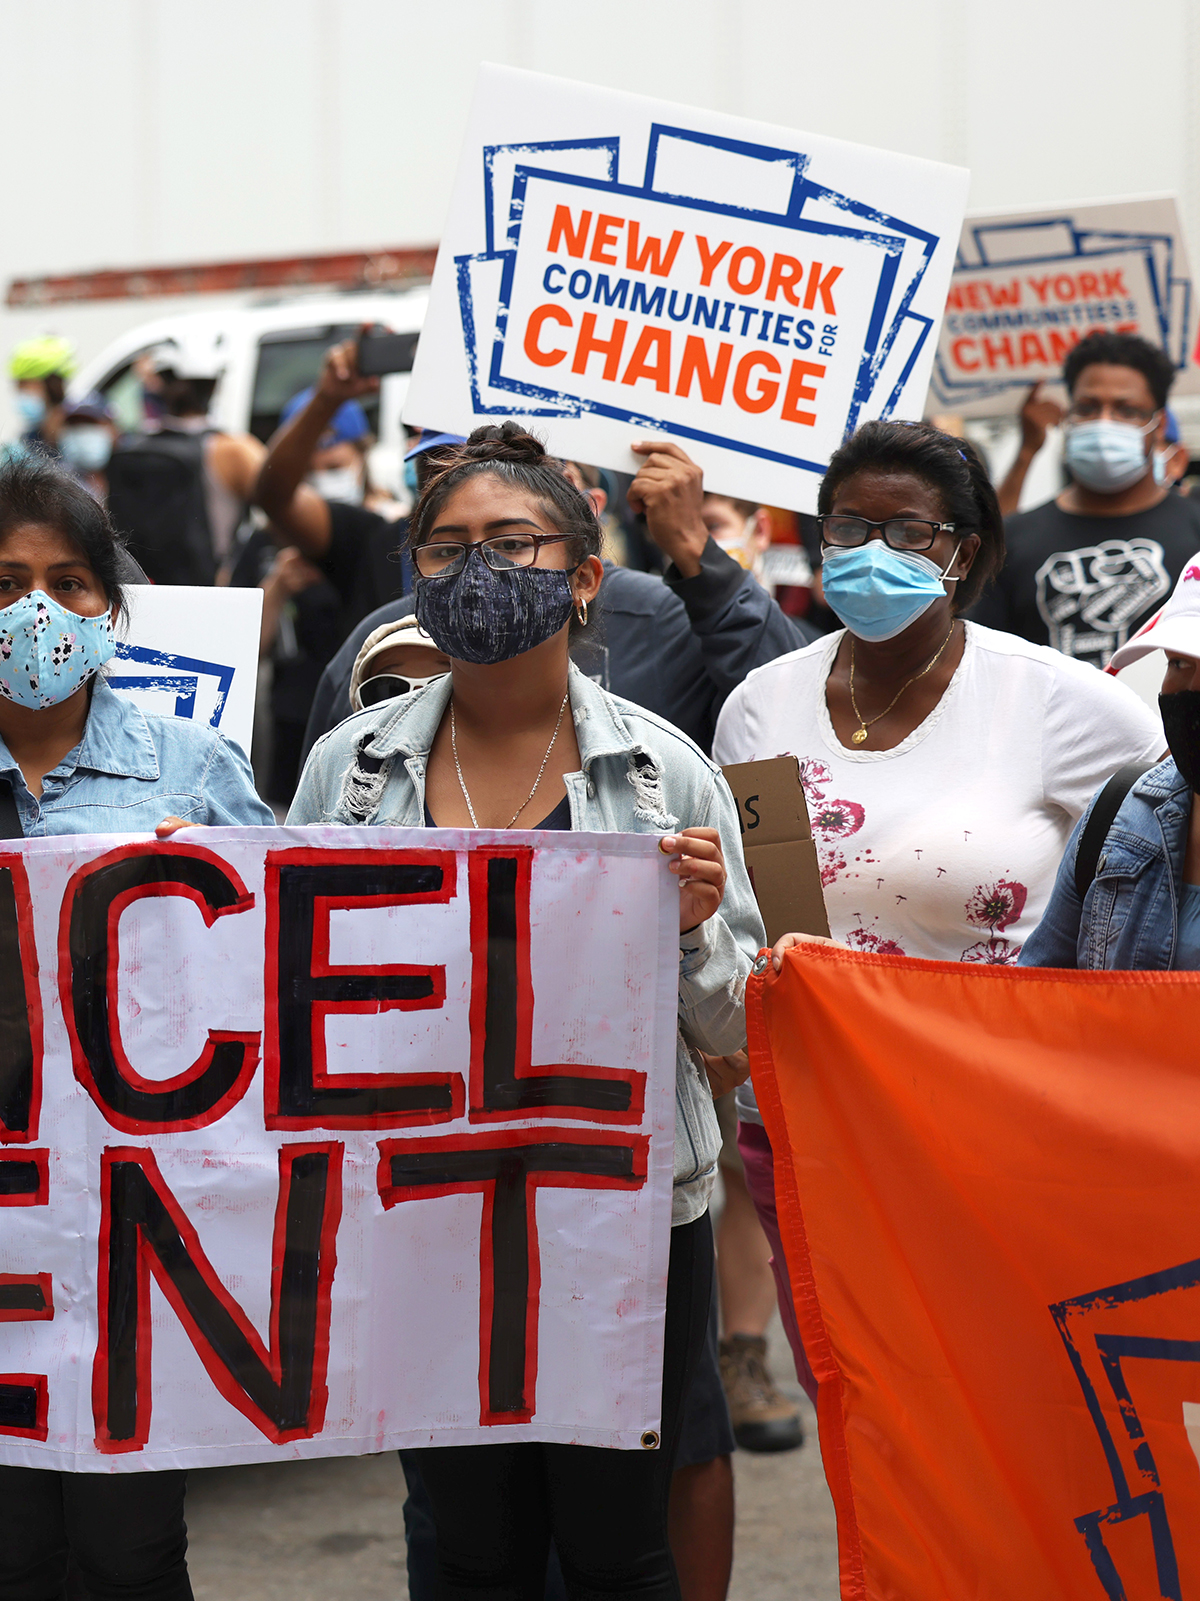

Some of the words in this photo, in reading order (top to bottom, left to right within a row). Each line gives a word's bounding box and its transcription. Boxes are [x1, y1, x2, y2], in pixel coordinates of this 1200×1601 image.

[546, 204, 685, 278] NEW
[695, 234, 844, 316] YORK
[543, 263, 816, 350] COMMUNITIES
[946, 280, 1020, 311] NEW
[1028, 269, 1128, 302] YORK
[818, 323, 838, 357] FOR
[947, 303, 1122, 335] COMMUNITIES
[523, 303, 827, 427] CHANGE
[952, 322, 1138, 374] CHAN
